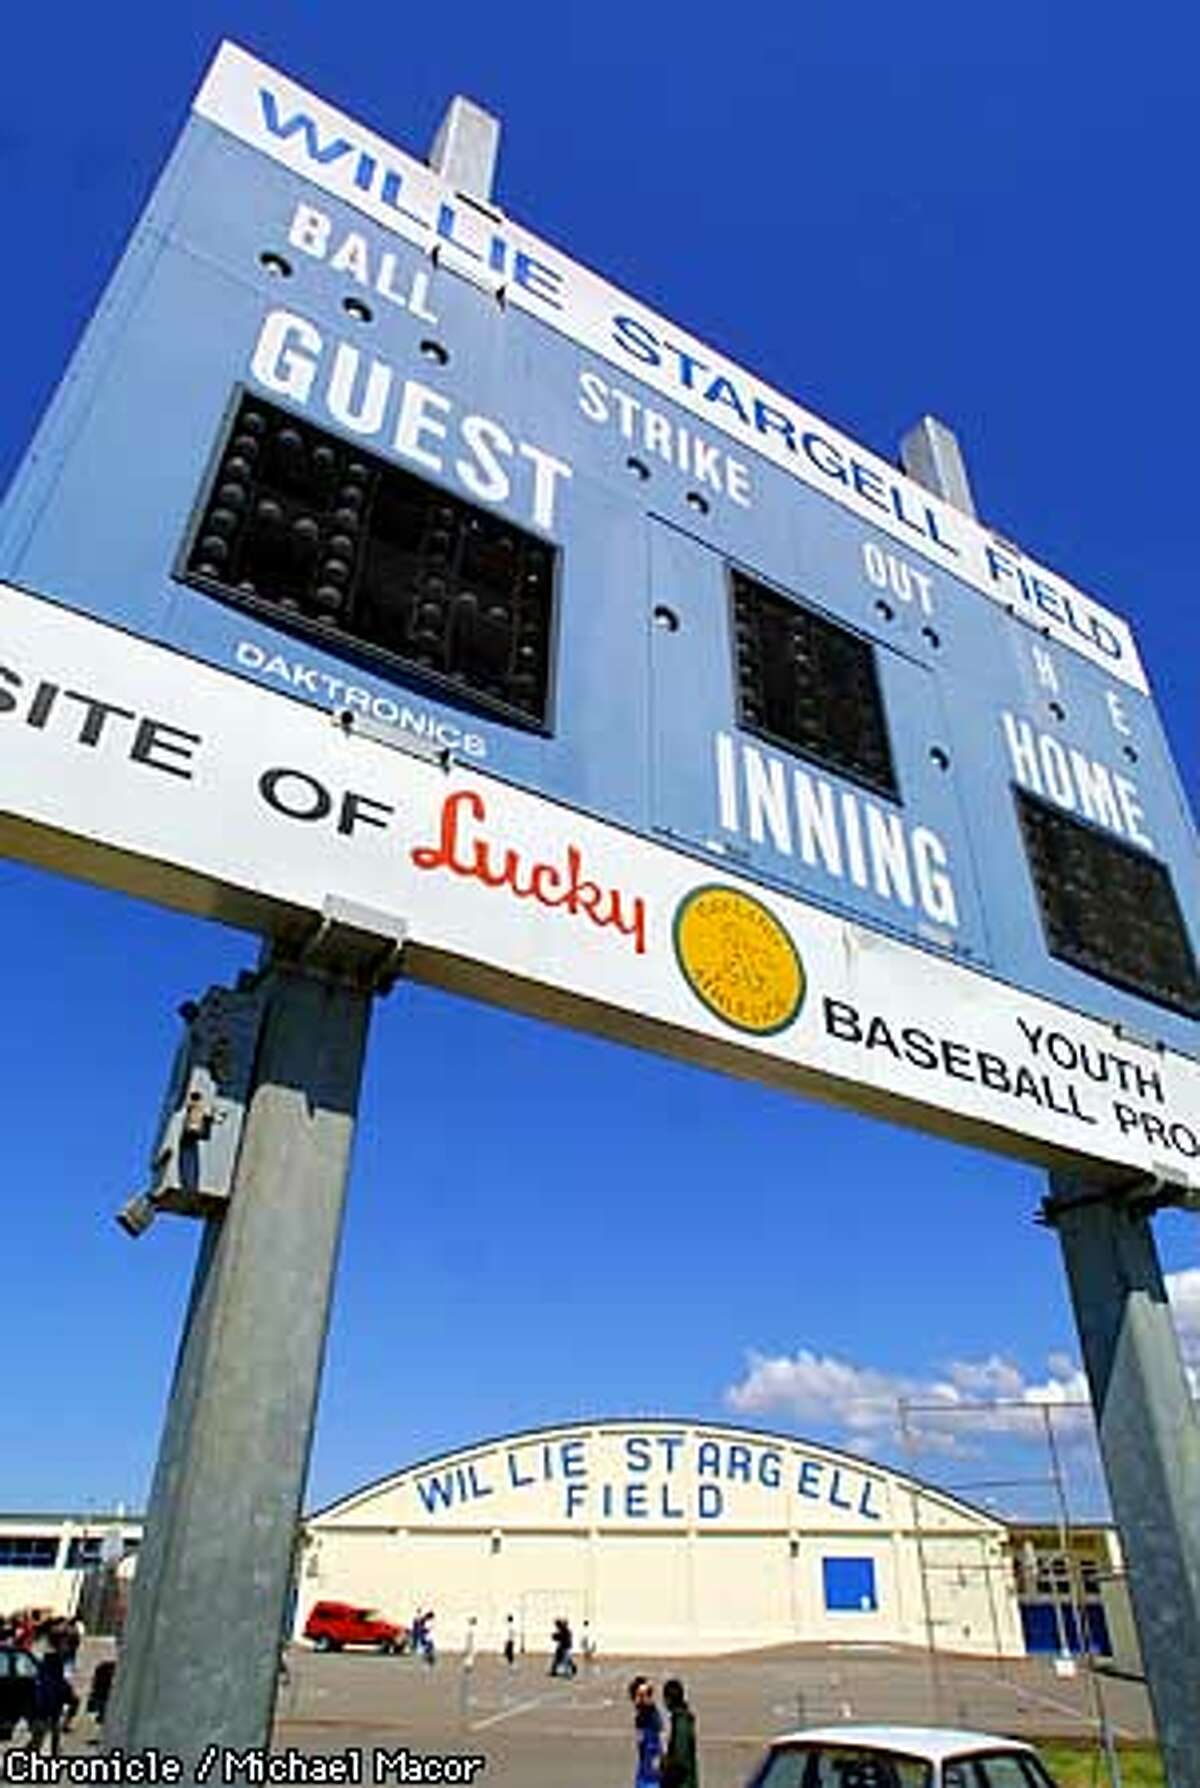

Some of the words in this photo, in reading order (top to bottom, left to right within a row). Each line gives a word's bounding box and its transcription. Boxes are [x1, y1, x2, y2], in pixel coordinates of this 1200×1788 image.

[288, 203, 439, 325] BALL
[250, 309, 573, 532] GUEST
[259, 88, 563, 311] WILLIE
[612, 314, 960, 557] STARGELL
[984, 546, 1122, 659] FIELD
[578, 373, 754, 507] STRIKE
[863, 543, 933, 614] OUT
[235, 642, 487, 757] DAKTRONICS
[1033, 644, 1059, 693] H
[1107, 691, 1132, 736] E
[259, 769, 394, 835] OF
[713, 733, 957, 926] INNING
[1002, 712, 1153, 848] HOME
[411, 790, 646, 954] Lucky
[823, 998, 1097, 1124] BASEBALL
[1016, 1017, 1164, 1104] YOUTH
[417, 1441, 588, 1514] WILLIE
[627, 1437, 882, 1519] STARGELL
[566, 1484, 724, 1518] FIELD
